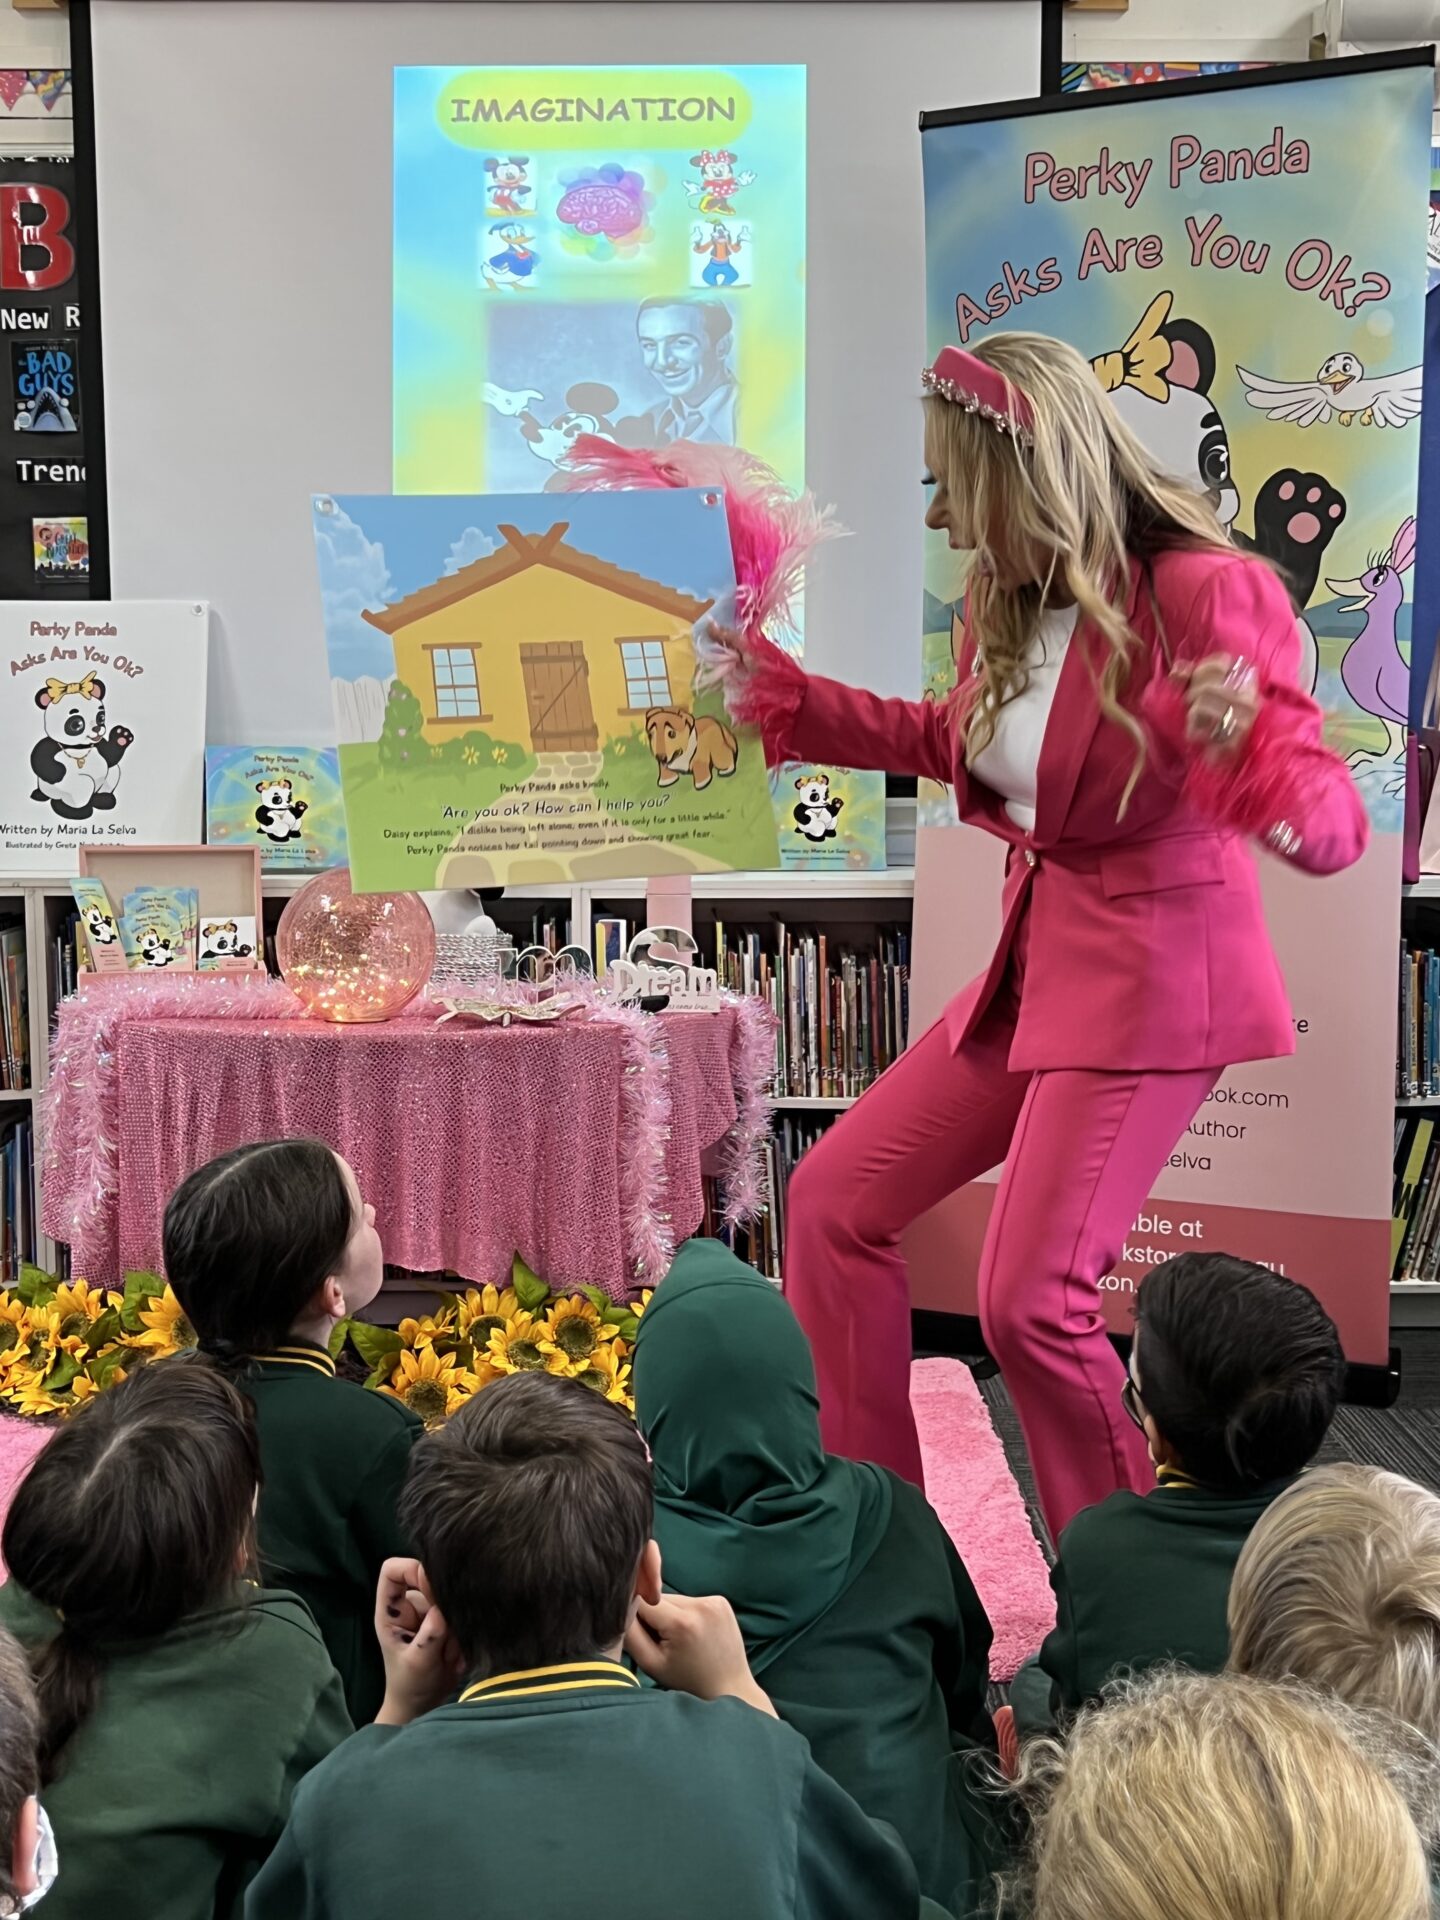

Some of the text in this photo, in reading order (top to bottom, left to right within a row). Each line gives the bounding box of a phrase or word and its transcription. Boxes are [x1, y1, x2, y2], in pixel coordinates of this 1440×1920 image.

[451, 97, 735, 122] IMAGINATION
[1024, 126, 1310, 208] Perky Panda
[955, 214, 1391, 343] Asks Are You Ok?
[1, 309, 49, 330] New
[26, 351, 72, 375] BAD
[18, 371, 74, 396] GUYS
[30, 621, 117, 640] Perky Panda
[10, 645, 144, 678] Asks Are You Ok?
[474, 808, 499, 821] you
[503, 802, 530, 816] ok?
[535, 801, 564, 814] How
[569, 802, 592, 813] can
[597, 798, 602, 812] I
[606, 798, 634, 812] help
[40, 824, 53, 837] by
[57, 823, 87, 835] Maria
[91, 823, 103, 834] La
[107, 823, 137, 835] Selva
[383, 829, 410, 840] Daisy
[467, 825, 497, 835] dislike
[500, 824, 525, 835] being
[528, 823, 545, 832] left
[578, 820, 600, 829] even
[602, 818, 609, 828] if
[611, 818, 618, 828] it
[632, 816, 650, 827] only
[653, 815, 666, 824] for
[678, 813, 699, 823] little
[45, 842, 53, 850] by
[407, 845, 434, 856] Perky
[436, 844, 465, 854] Panda
[468, 842, 503, 852] notices
[505, 841, 520, 850] her
[524, 840, 539, 849] tail
[541, 837, 579, 849] pointing
[581, 836, 605, 846] down
[608, 834, 624, 844] and
[665, 831, 689, 842] great
[609, 959, 718, 998] Dream
[1179, 1220, 1203, 1238] at
